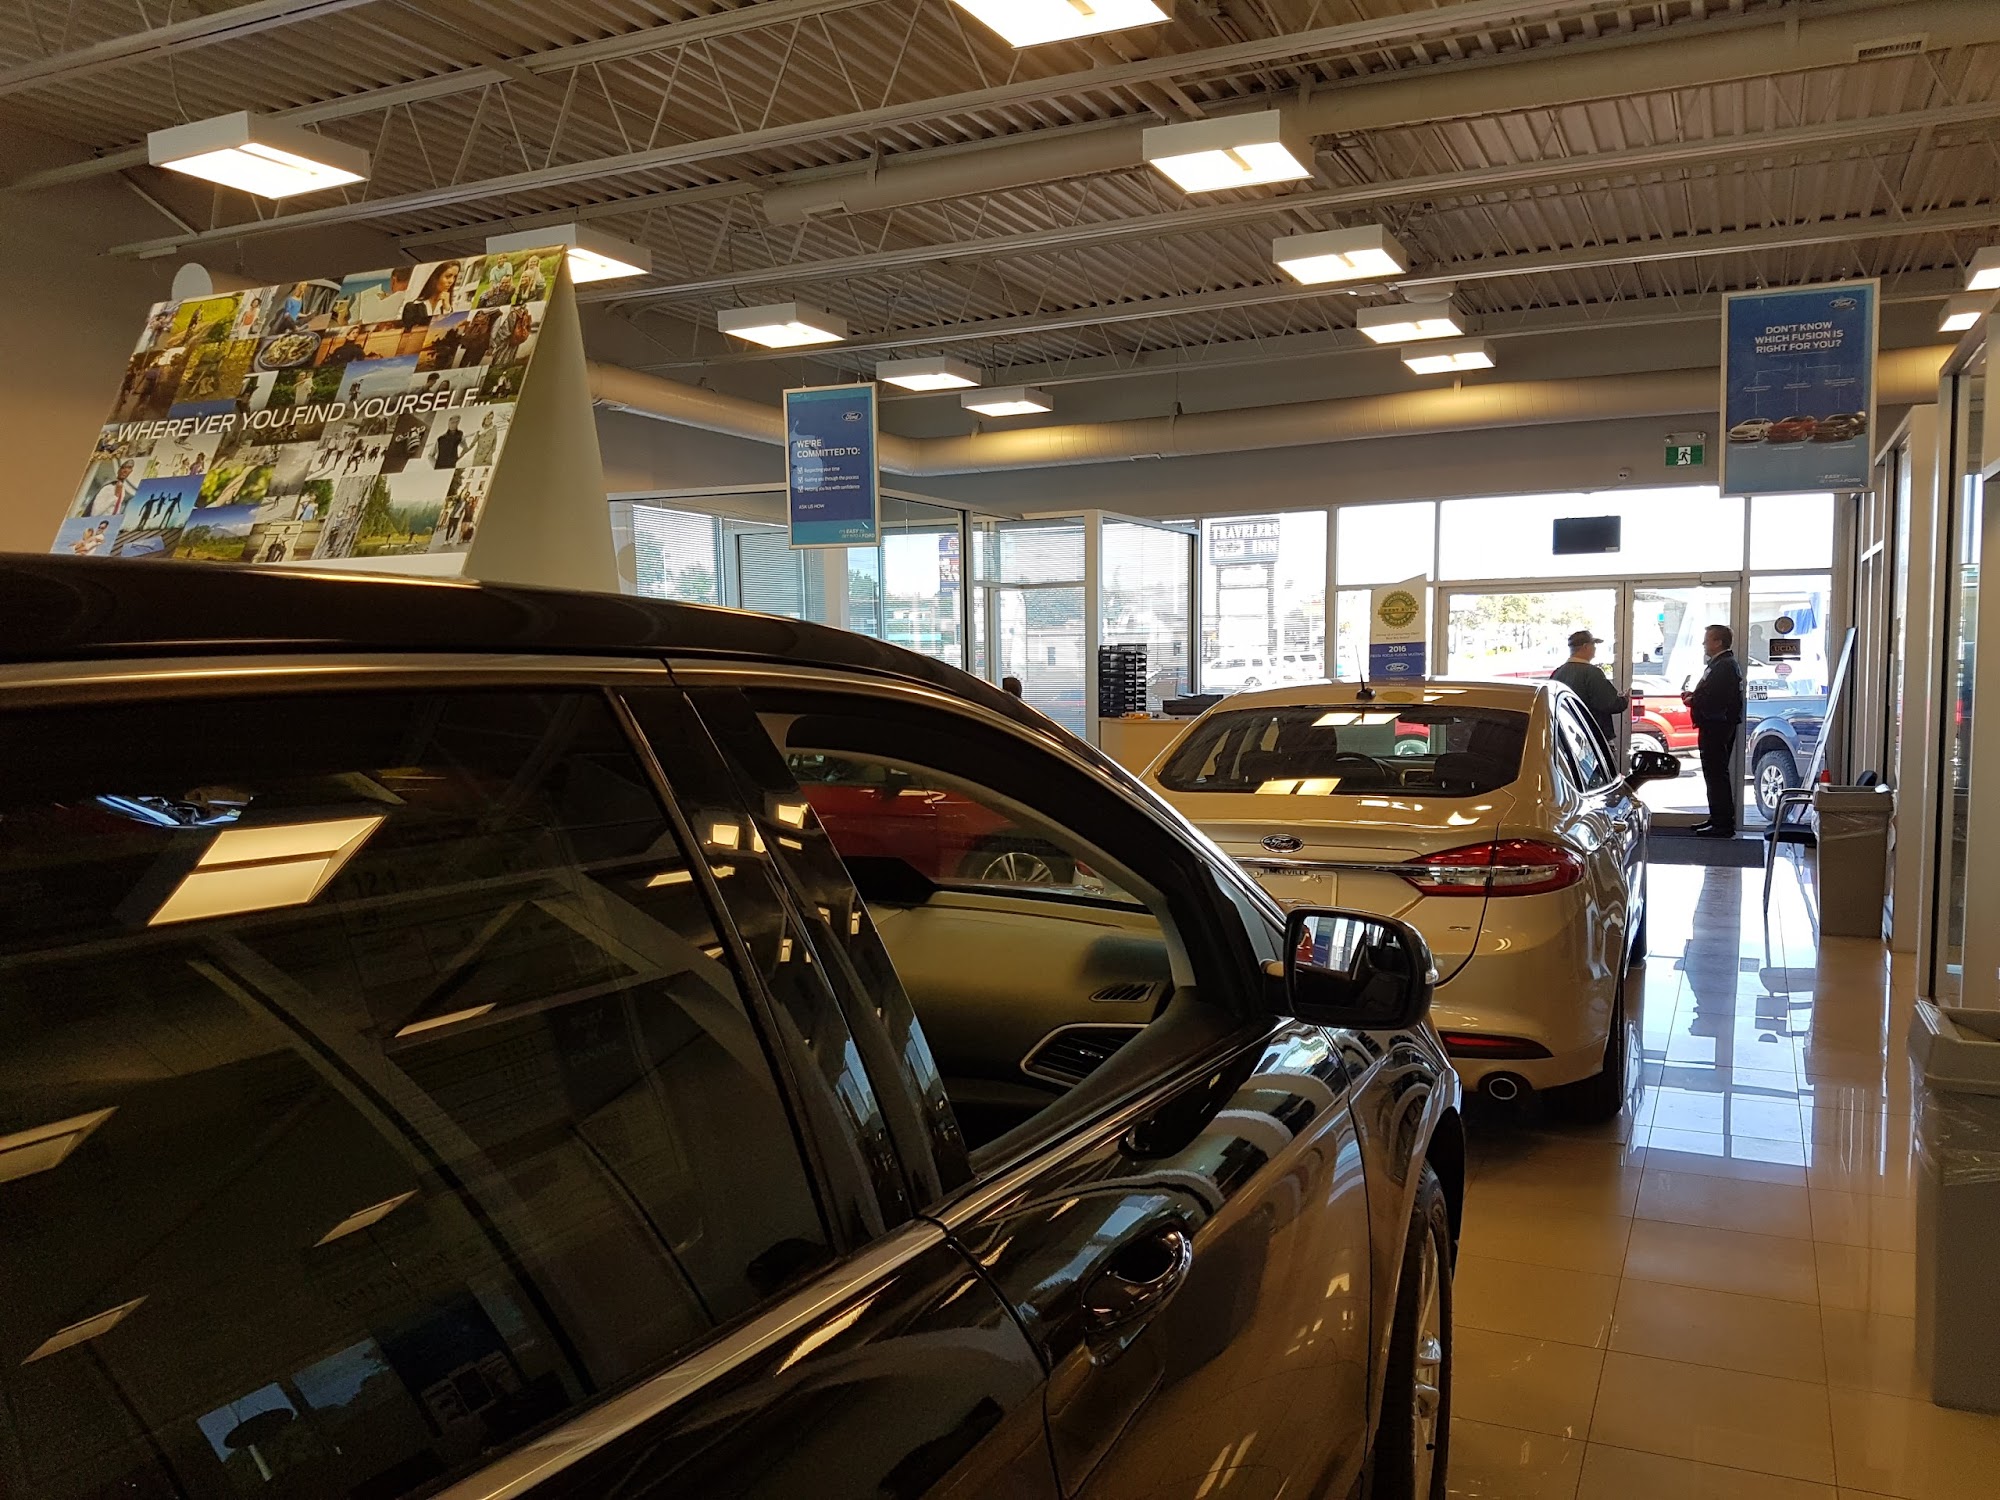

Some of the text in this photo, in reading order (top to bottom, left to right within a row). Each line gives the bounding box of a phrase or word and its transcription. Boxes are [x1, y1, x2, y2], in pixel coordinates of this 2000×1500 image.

[1765, 321, 1833, 334] DON'T KNOW
[1754, 329, 1844, 344] WHICH FUSION IS
[1755, 339, 1842, 354] RIGHT FOR YOU?
[117, 387, 491, 442] WHEREVER YOU FIND YOURSELF...
[796, 439, 822, 448] WE'RE
[796, 446, 861, 458] COMMITTED TO:
[1388, 645, 1407, 653] 2016
